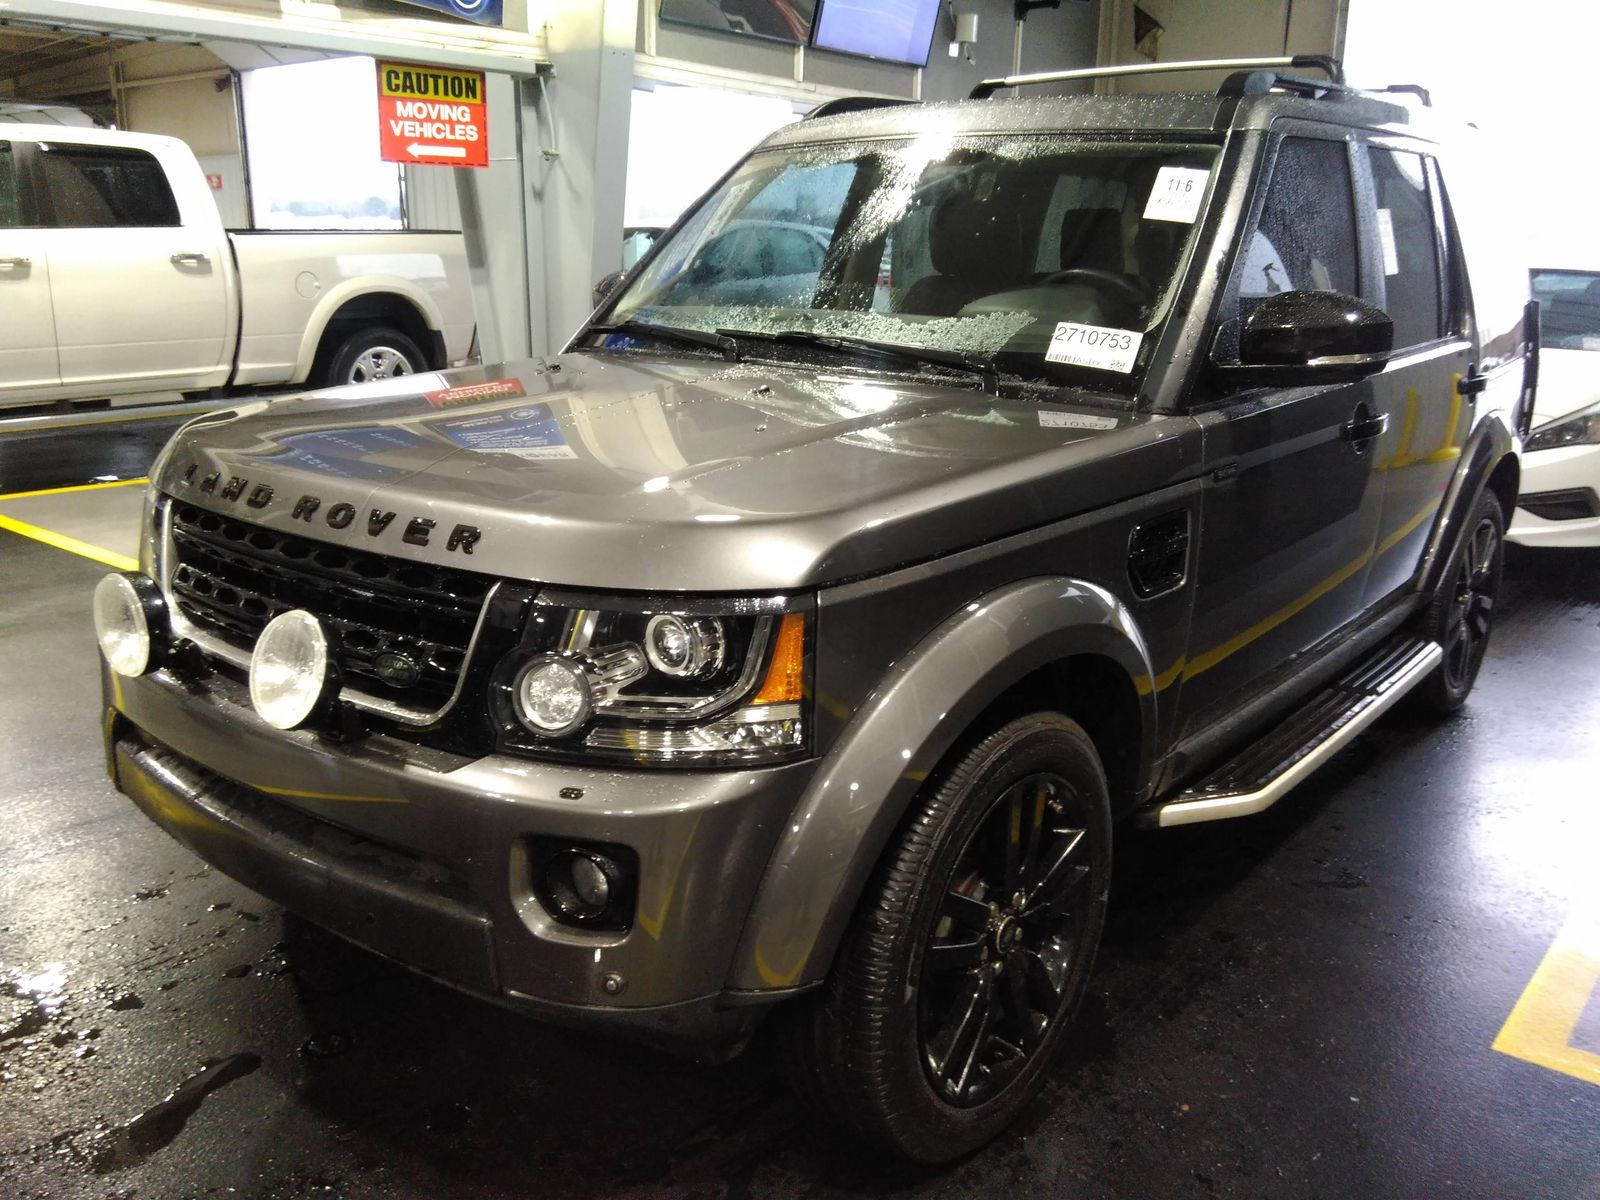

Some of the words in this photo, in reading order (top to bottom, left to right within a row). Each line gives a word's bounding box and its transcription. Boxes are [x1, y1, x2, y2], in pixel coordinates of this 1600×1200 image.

[386, 69, 477, 99] CAUTION
[396, 101, 471, 122] MOVING
[389, 120, 479, 141] VEHICLES
[1054, 326, 1131, 350] 2710753
[181, 464, 274, 509] LAND
[292, 494, 482, 555] ROVER
